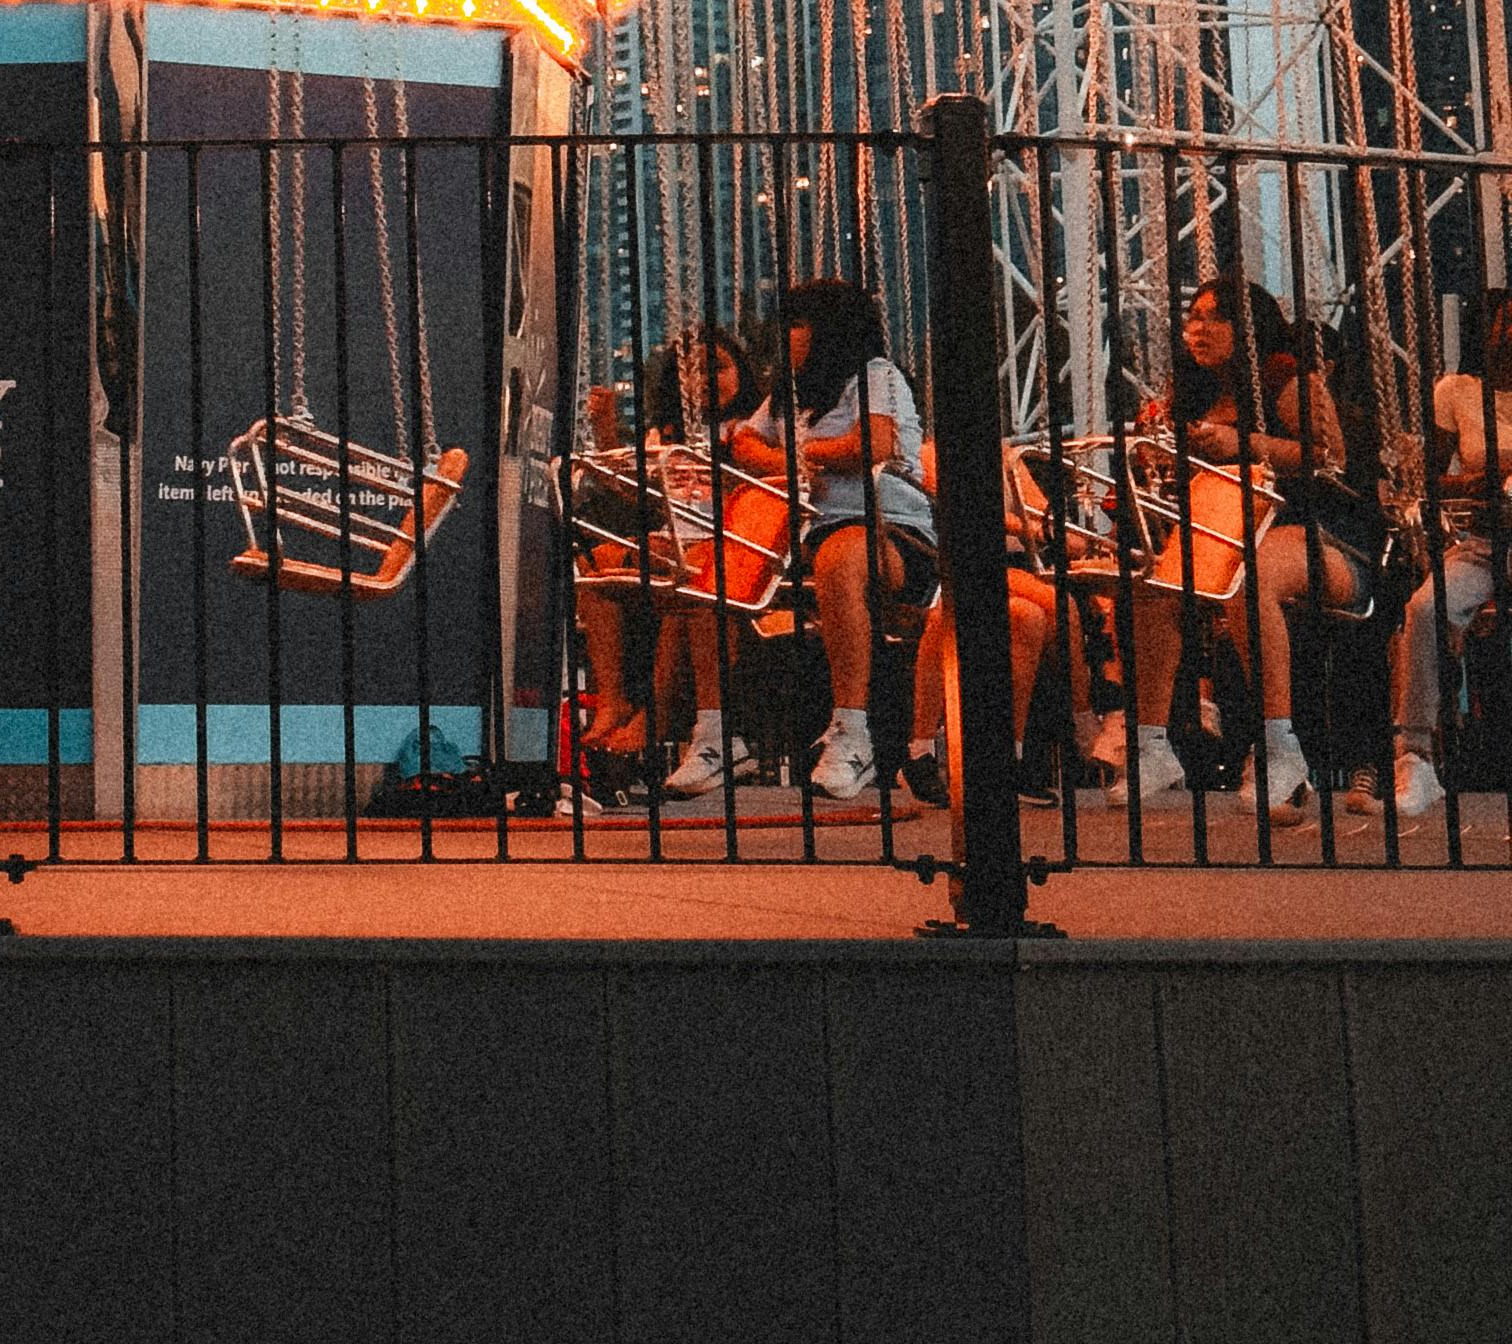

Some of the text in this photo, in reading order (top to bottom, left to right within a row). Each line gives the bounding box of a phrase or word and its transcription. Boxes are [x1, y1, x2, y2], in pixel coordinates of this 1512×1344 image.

[218, 456, 250, 474] Per
[299, 461, 391, 480] respsible
[158, 482, 195, 500] item
[206, 484, 235, 502] left
[359, 490, 385, 506] the
